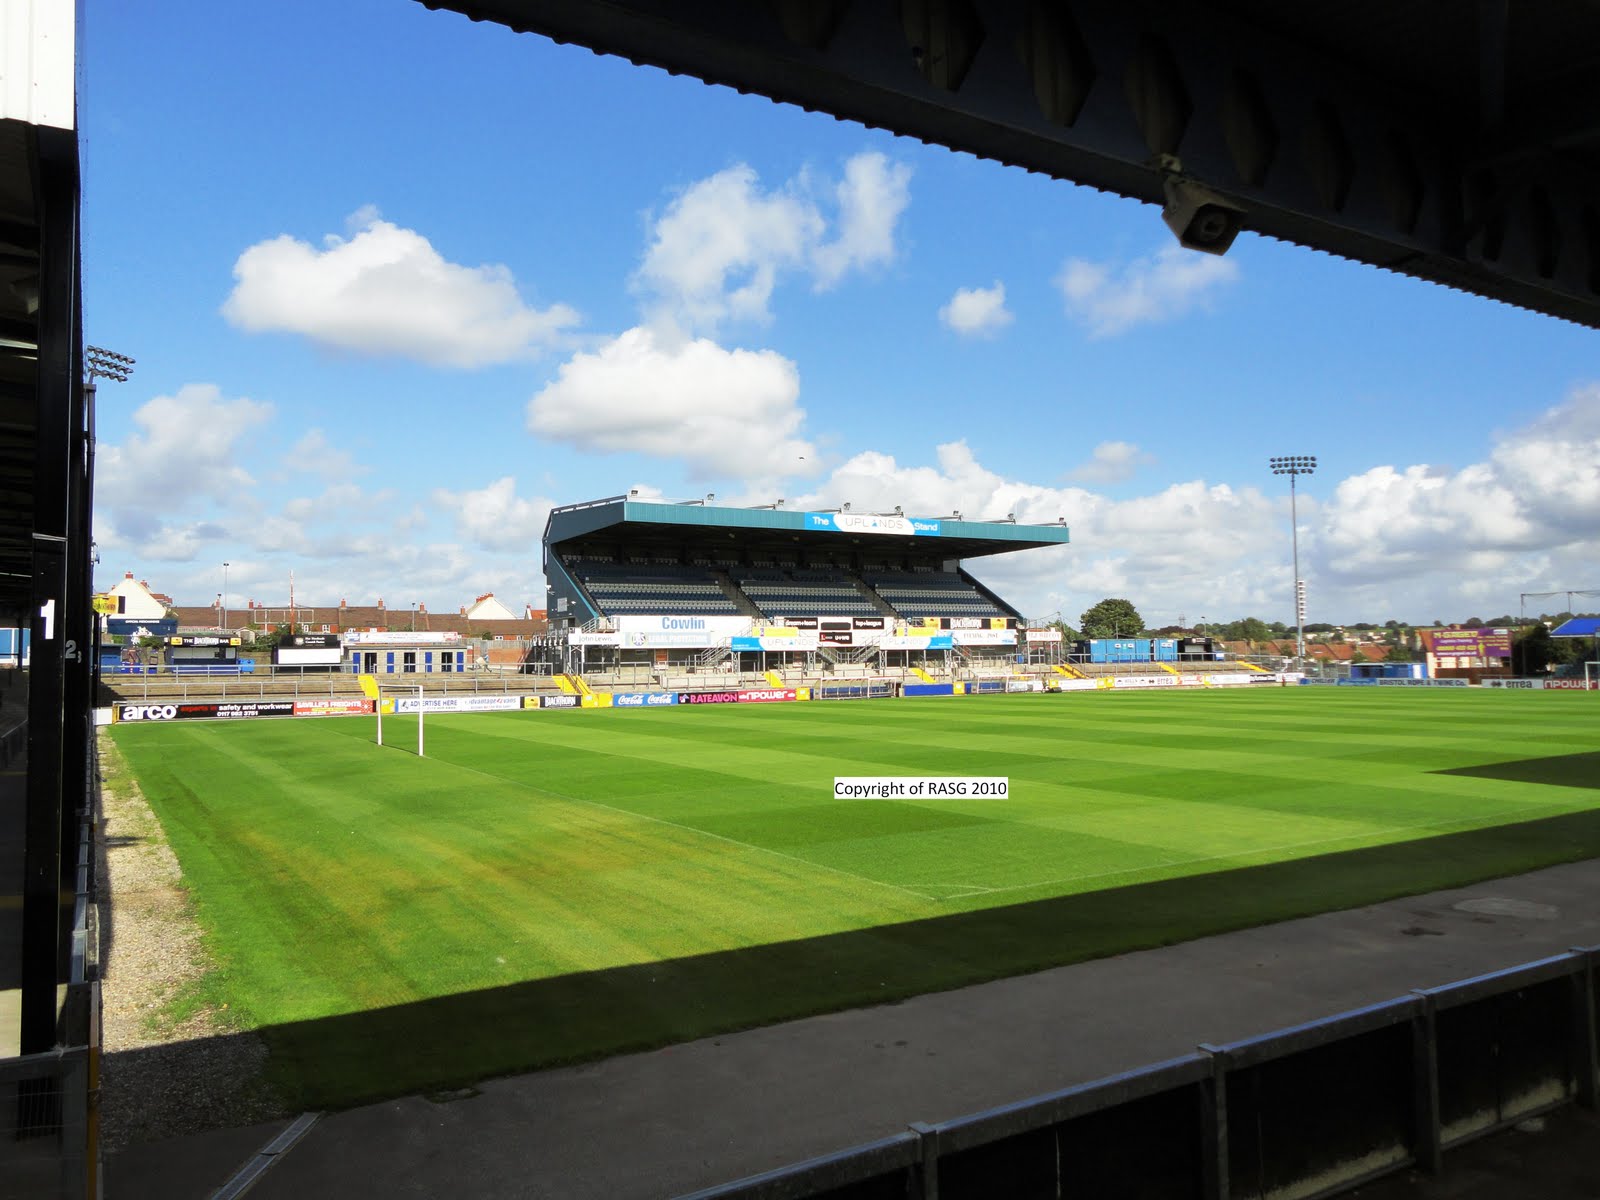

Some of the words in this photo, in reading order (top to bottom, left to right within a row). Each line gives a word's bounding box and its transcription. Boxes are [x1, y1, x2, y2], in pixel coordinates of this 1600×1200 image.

[812, 516, 829, 525] The
[845, 517, 904, 529] UPLANDS
[914, 522, 938, 531] Stand
[40, 599, 55, 640] 1
[662, 616, 705, 630] Cowlin
[578, 635, 595, 643] John
[65, 640, 77, 659] 2
[690, 693, 738, 703] RATEAVON
[746, 690, 788, 700] npower
[122, 704, 177, 720] arco
[218, 704, 241, 712] safety
